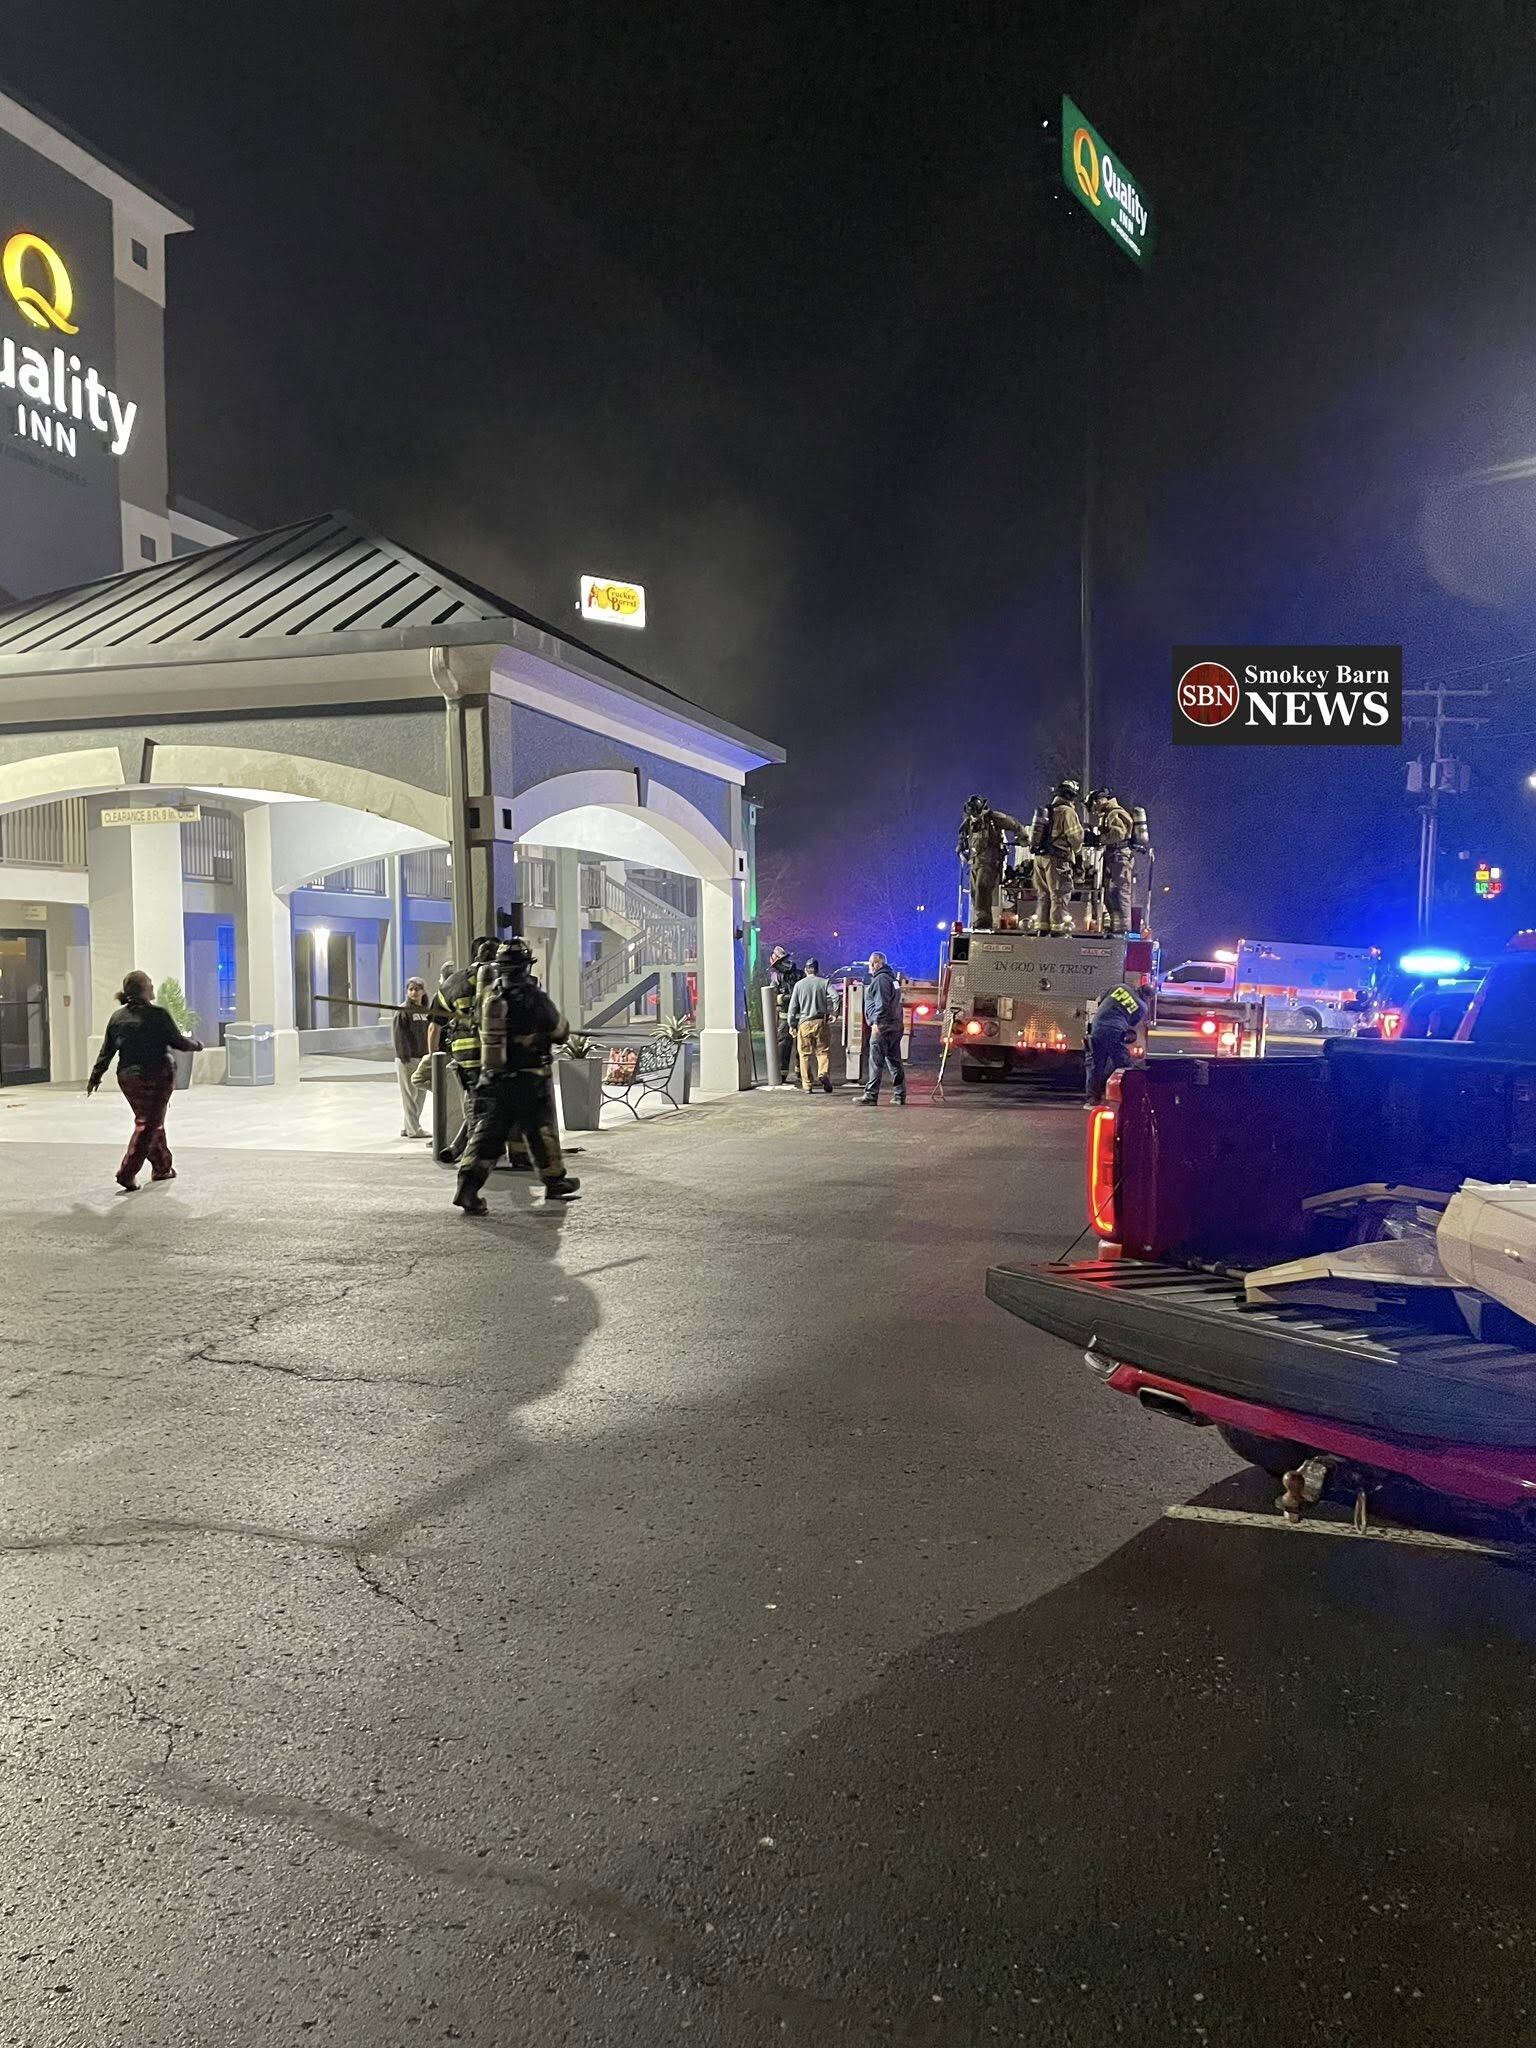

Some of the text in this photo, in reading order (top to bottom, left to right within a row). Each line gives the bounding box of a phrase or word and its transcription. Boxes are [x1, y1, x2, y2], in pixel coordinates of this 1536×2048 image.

[1102, 154, 1148, 237] Quality
[17, 403, 77, 458] INN
[104, 810, 145, 824] CLEARANCE
[995, 960, 1098, 975] IN GOD WE TRUST
